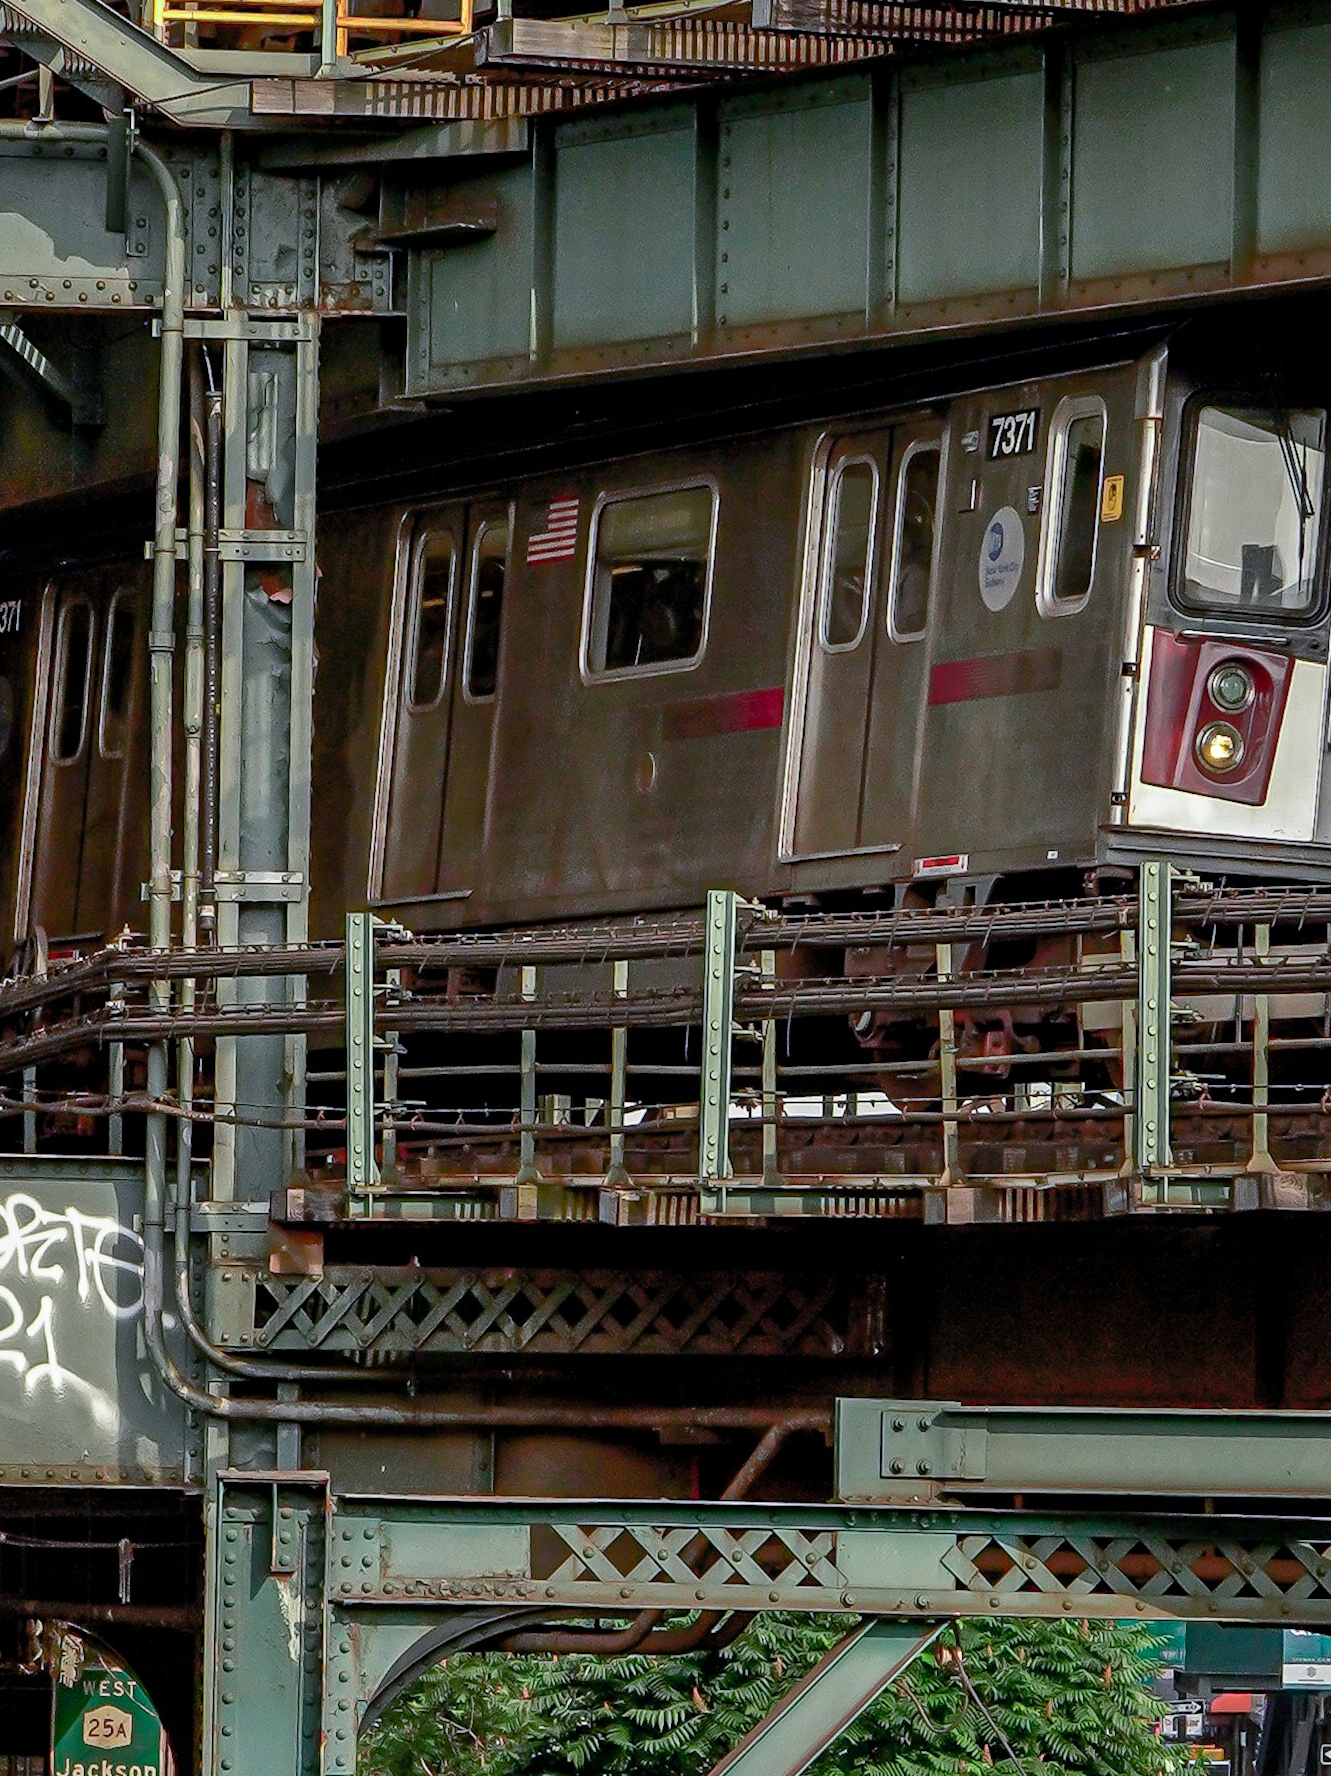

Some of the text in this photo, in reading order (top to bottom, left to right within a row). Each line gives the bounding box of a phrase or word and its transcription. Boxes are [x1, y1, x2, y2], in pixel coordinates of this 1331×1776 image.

[991, 411, 1036, 457] 7371
[82, 1680, 138, 1699] WEST
[88, 1718, 128, 1740] 25A
